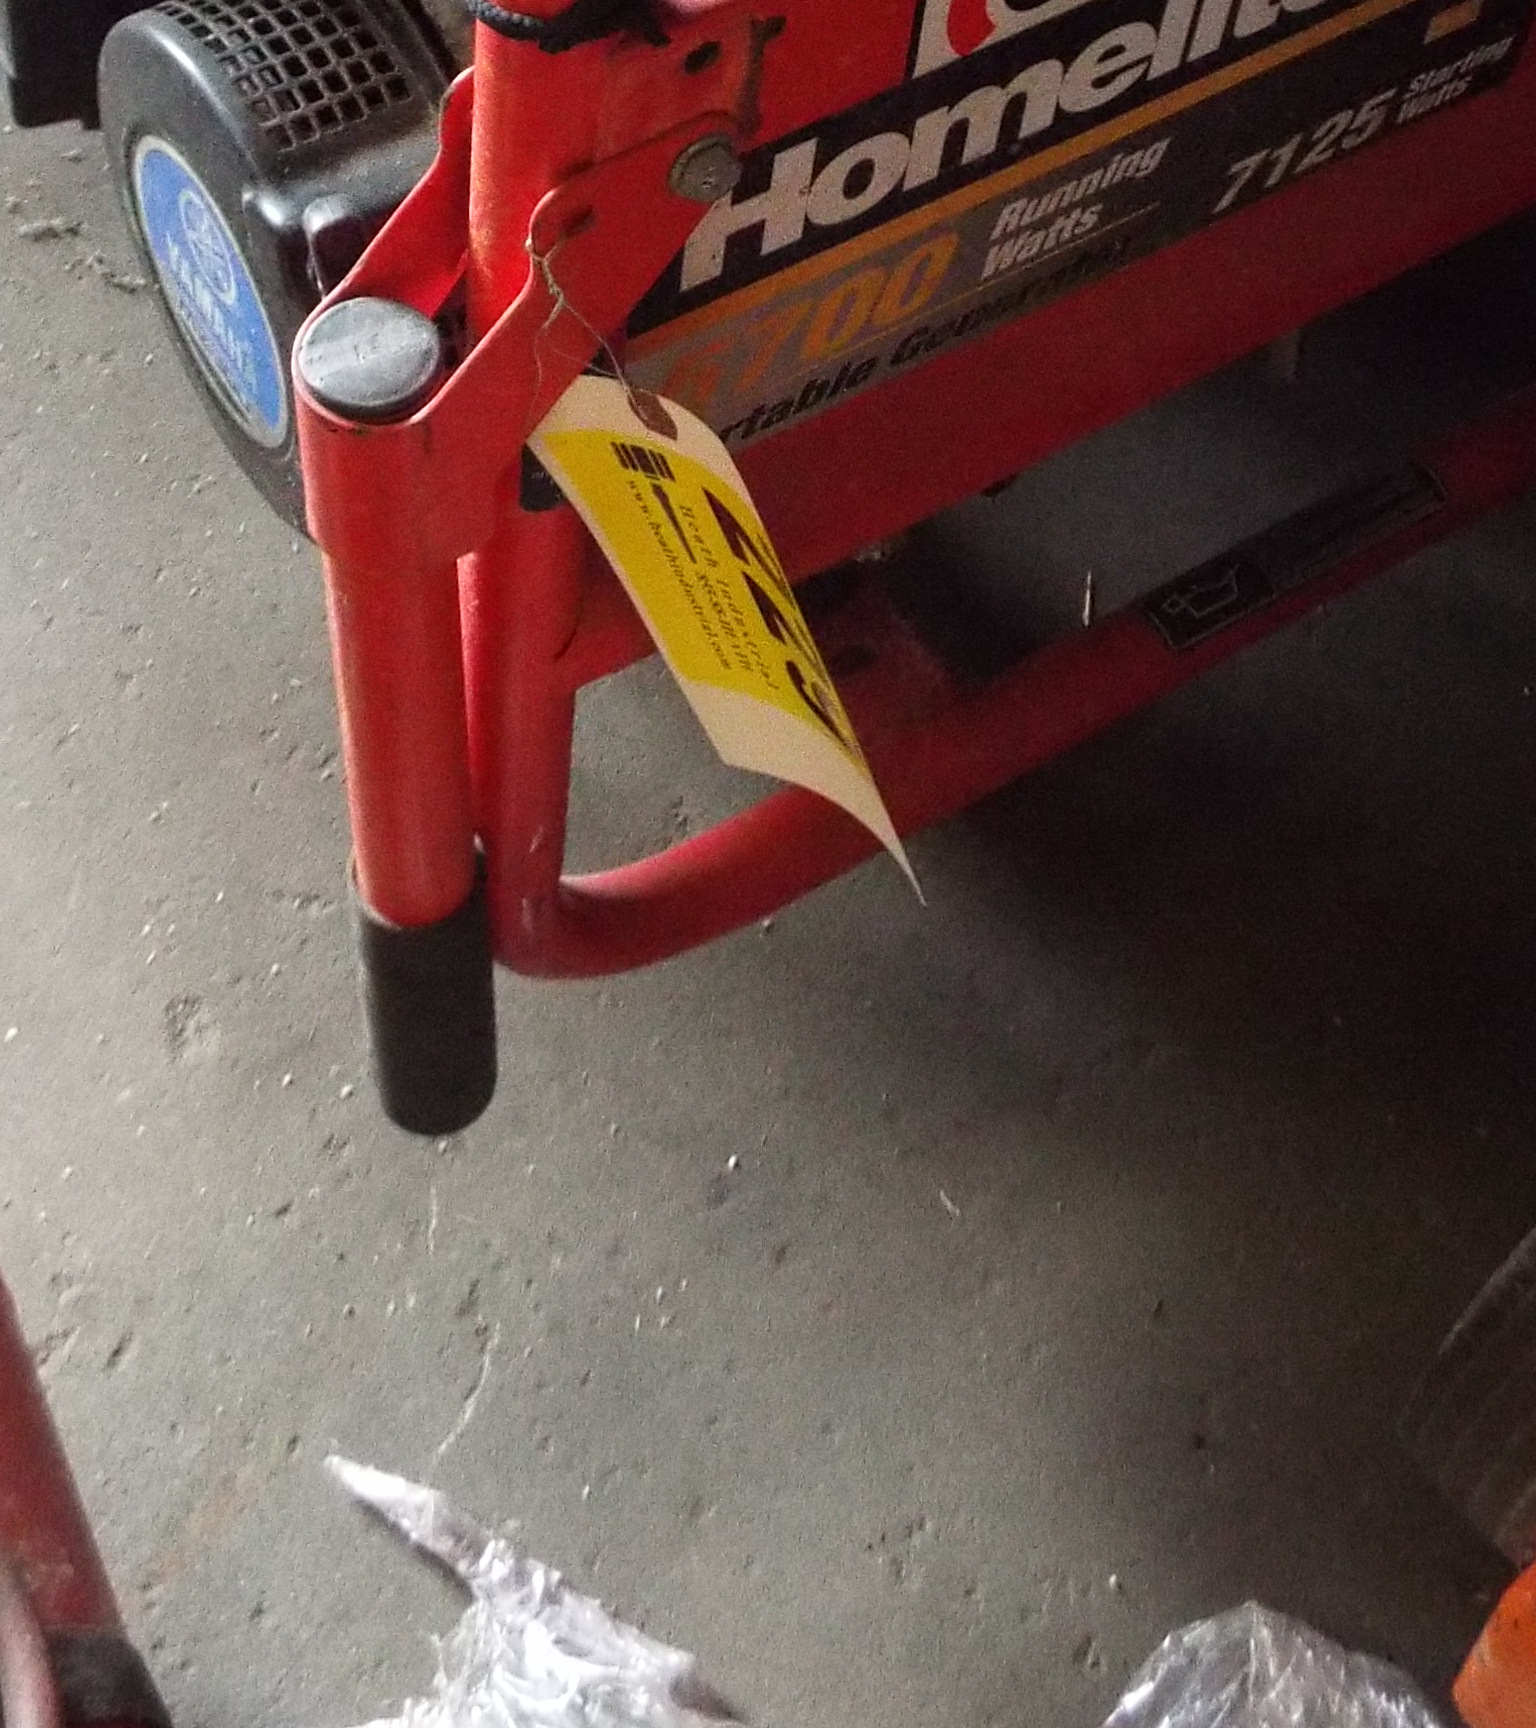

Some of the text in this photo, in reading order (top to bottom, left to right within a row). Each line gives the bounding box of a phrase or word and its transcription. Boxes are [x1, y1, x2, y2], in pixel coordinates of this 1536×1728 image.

[990, 136, 1173, 239] Running
[1213, 86, 1398, 214] 7125
[980, 202, 1105, 281] Watts
